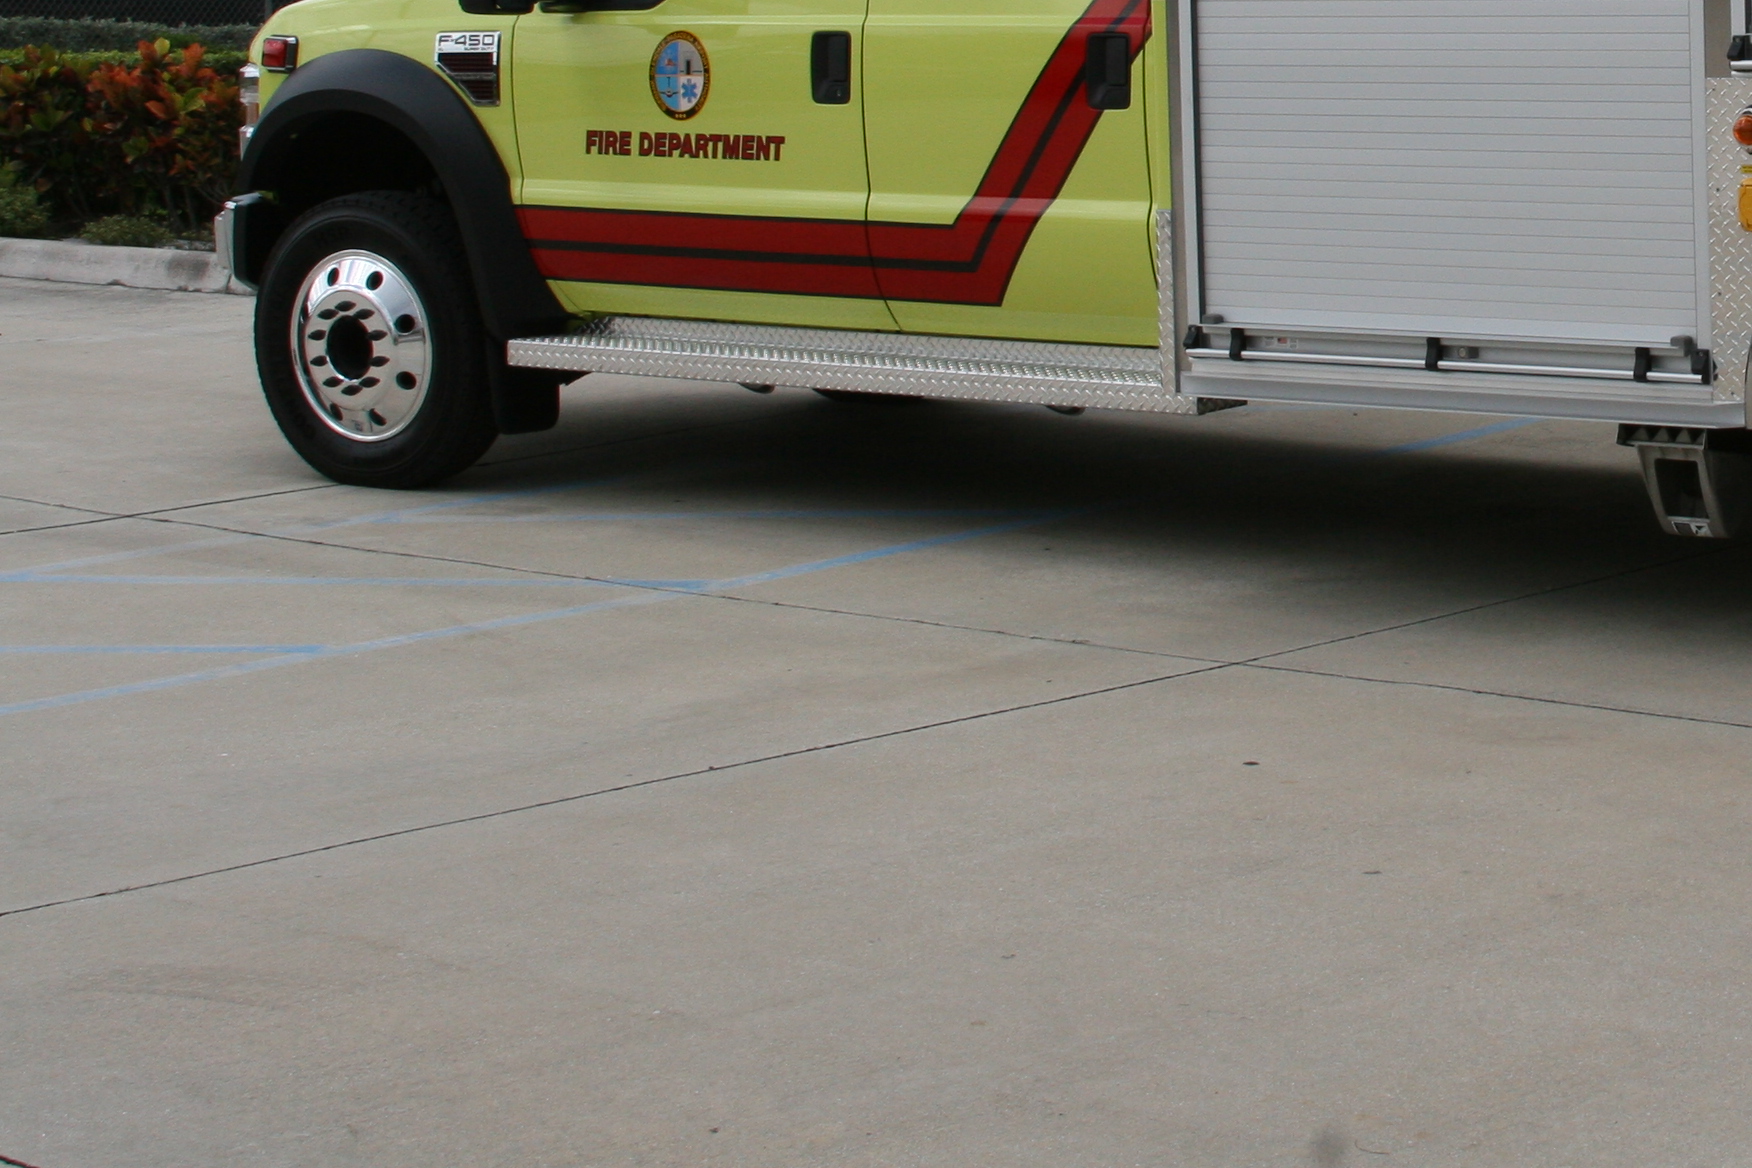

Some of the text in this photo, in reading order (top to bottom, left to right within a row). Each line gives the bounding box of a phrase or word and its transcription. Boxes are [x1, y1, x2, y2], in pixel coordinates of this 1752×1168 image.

[438, 34, 495, 46] F-450
[585, 129, 786, 162] FIRE DEPARTMENT
